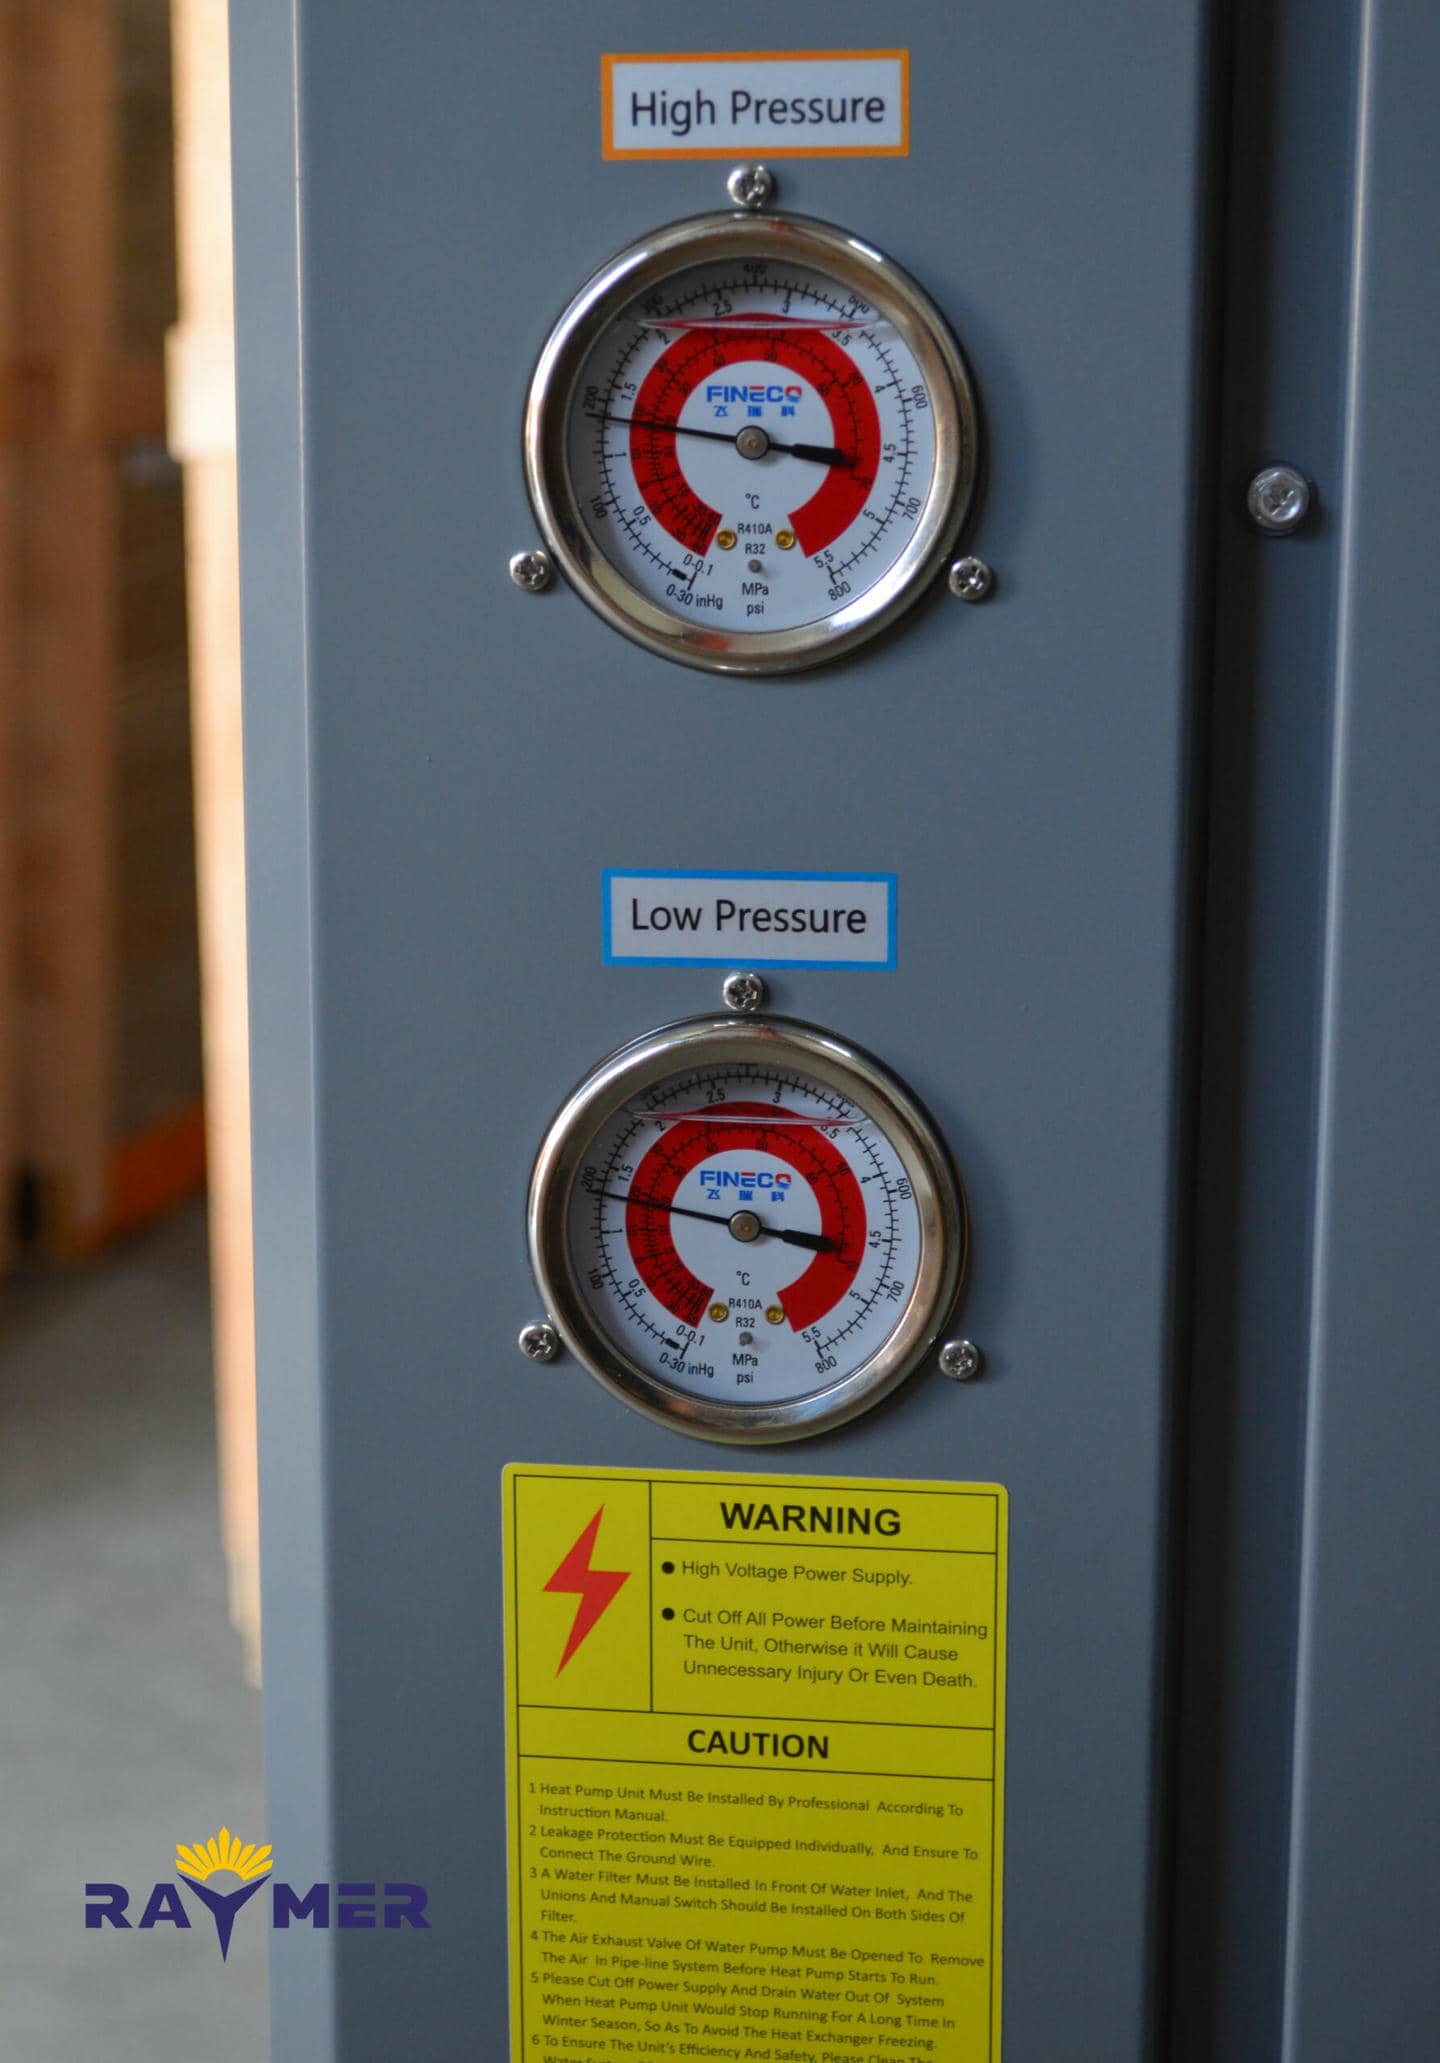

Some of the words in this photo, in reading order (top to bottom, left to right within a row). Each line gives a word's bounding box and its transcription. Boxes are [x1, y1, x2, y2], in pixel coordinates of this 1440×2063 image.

[631, 90, 716, 136] High
[731, 89, 886, 125] Pressure
[582, 385, 599, 410] 200
[621, 382, 637, 400] 1.5
[706, 385, 803, 403] FINECO
[911, 385, 928, 409] 600
[883, 443, 897, 463] 4.5
[591, 495, 607, 519] 100
[633, 505, 651, 526] 0.5
[863, 508, 875, 520] 5
[901, 497, 921, 521] 700
[738, 523, 773, 535] R410A
[745, 543, 766, 555] R32
[813, 550, 834, 569] 5.5
[666, 583, 693, 605] 0-30
[695, 594, 723, 610] inHg
[742, 582, 769, 596] MPa
[828, 581, 851, 601] 800
[747, 600, 764, 616] psi
[631, 898, 702, 931] Low
[716, 899, 867, 934] Pressure
[706, 1088, 726, 1104] 2.5
[581, 1166, 597, 1188] 200
[618, 1164, 634, 1183] 1.5
[699, 1170, 792, 1190] FINECO
[896, 1177, 913, 1200] 600
[868, 1230, 882, 1249] 4.5
[588, 1268, 604, 1291] 100
[628, 1278, 647, 1298] 0.5
[849, 1289, 861, 1301] 5
[886, 1280, 905, 1303] 700
[728, 1298, 763, 1310] R410A
[735, 1317, 756, 1328] R32
[801, 1326, 821, 1343] 5.5
[659, 1352, 686, 1373] 0-30
[688, 1364, 714, 1378] inHg
[732, 1353, 759, 1367] MPa
[814, 1355, 837, 1374] 800
[736, 1372, 754, 1384] psi
[720, 1502, 901, 1537] WARNING
[682, 1560, 720, 1579] High
[725, 1562, 788, 1582] Voltage
[793, 1565, 846, 1581] Power
[852, 1568, 912, 1588] Supply.
[682, 1608, 712, 1624] Cut
[716, 1609, 742, 1624] Off
[746, 1611, 766, 1625] All
[772, 1612, 824, 1629] Power
[830, 1615, 886, 1632] Before
[891, 1618, 988, 1640] Maintaining
[683, 1634, 715, 1650] The
[720, 1636, 758, 1653] Unit,
[764, 1637, 848, 1656] Otherwise
[854, 1642, 862, 1656] it
[868, 1643, 898, 1658] Will
[904, 1644, 958, 1661] Cause
[684, 1660, 792, 1682] Unnecessary
[798, 1665, 843, 1684] Injury
[848, 1667, 869, 1682] Or
[874, 1669, 916, 1685] Even
[922, 1671, 978, 1687] Death.
[687, 1729, 829, 1759] CAUTION
[528, 1782, 536, 1794] 1
[540, 1782, 571, 1795] Heat
[574, 1784, 614, 1800] Pump
[616, 1786, 646, 1800] Unit
[648, 1788, 683, 1802] Must
[686, 1790, 704, 1803] Be
[707, 1791, 764, 1806] Installed
[768, 1794, 784, 1809] By
[788, 1795, 870, 1811] Professional
[876, 1800, 944, 1818] According
[948, 1803, 964, 1816] To
[539, 1804, 610, 1819] Instruction
[614, 1807, 667, 1822] Manual.
[528, 1824, 536, 1836] 2
[540, 1825, 594, 1842] Leakage
[596, 1827, 666, 1843] Protection
[669, 1832, 704, 1846] Must
[707, 1834, 725, 1847] Be
[728, 1835, 791, 1851] Equipped
[794, 1839, 874, 1856] Individually,
[882, 1843, 910, 1856] And
[912, 1845, 959, 1859] Ensure
[962, 1847, 978, 1860] To
[539, 1845, 594, 1861] Connect
[597, 1847, 622, 1863] The
[625, 1851, 676, 1865] Ground
[679, 1854, 715, 1867] Wire.
[529, 1866, 538, 1879] 3
[540, 1867, 551, 1878] A
[554, 1868, 595, 1882] Water
[598, 1870, 632, 1884] Filter
[635, 1872, 670, 1886] Must
[672, 1874, 690, 1887] Be
[694, 1875, 750, 1891] Installed
[754, 1879, 768, 1892] In
[771, 1880, 806, 1894] Front
[810, 1882, 828, 1894] Of
[829, 1883, 872, 1897] Water
[875, 1886, 910, 1900] Inlet,
[916, 1888, 944, 1901] And
[947, 1889, 973, 1903] The
[540, 1888, 586, 1902] Unions
[589, 1891, 616, 1904] And
[620, 1892, 670, 1907] Manual
[673, 1895, 718, 1909] Switch
[720, 1898, 767, 1912] Should
[770, 1901, 788, 1914] Be
[790, 1903, 848, 1917] Installed
[850, 1905, 871, 1918] On
[874, 1907, 906, 1920] Both
[910, 1909, 946, 1922] Sides
[948, 1911, 966, 1923] Of
[540, 1909, 576, 1922] Filter.
[530, 1971, 539, 1983] 5
[542, 1971, 584, 1986] Please
[587, 1975, 610, 1988] Cut
[613, 1976, 634, 1989] Off
[638, 1977, 680, 1991] Power
[682, 1980, 728, 1997] Supply
[730, 1983, 758, 1997] And
[760, 1985, 796, 1999] Drain
[800, 1988, 841, 2001] Water
[844, 1989, 870, 2003] Out
[872, 1991, 890, 2004] Of
[896, 1992, 944, 2008] System
[542, 2014, 588, 2028] Winter
[590, 2016, 641, 2032] Season,
[644, 2019, 662, 2032] So
[664, 2021, 680, 2034] As
[683, 2021, 699, 2035] To
[702, 2023, 740, 2037] Avoid
[742, 2025, 768, 2039] The
[770, 2028, 802, 2041] Heat
[806, 2029, 874, 2047] Exchanger
[878, 2033, 936, 2051] Freezing.
